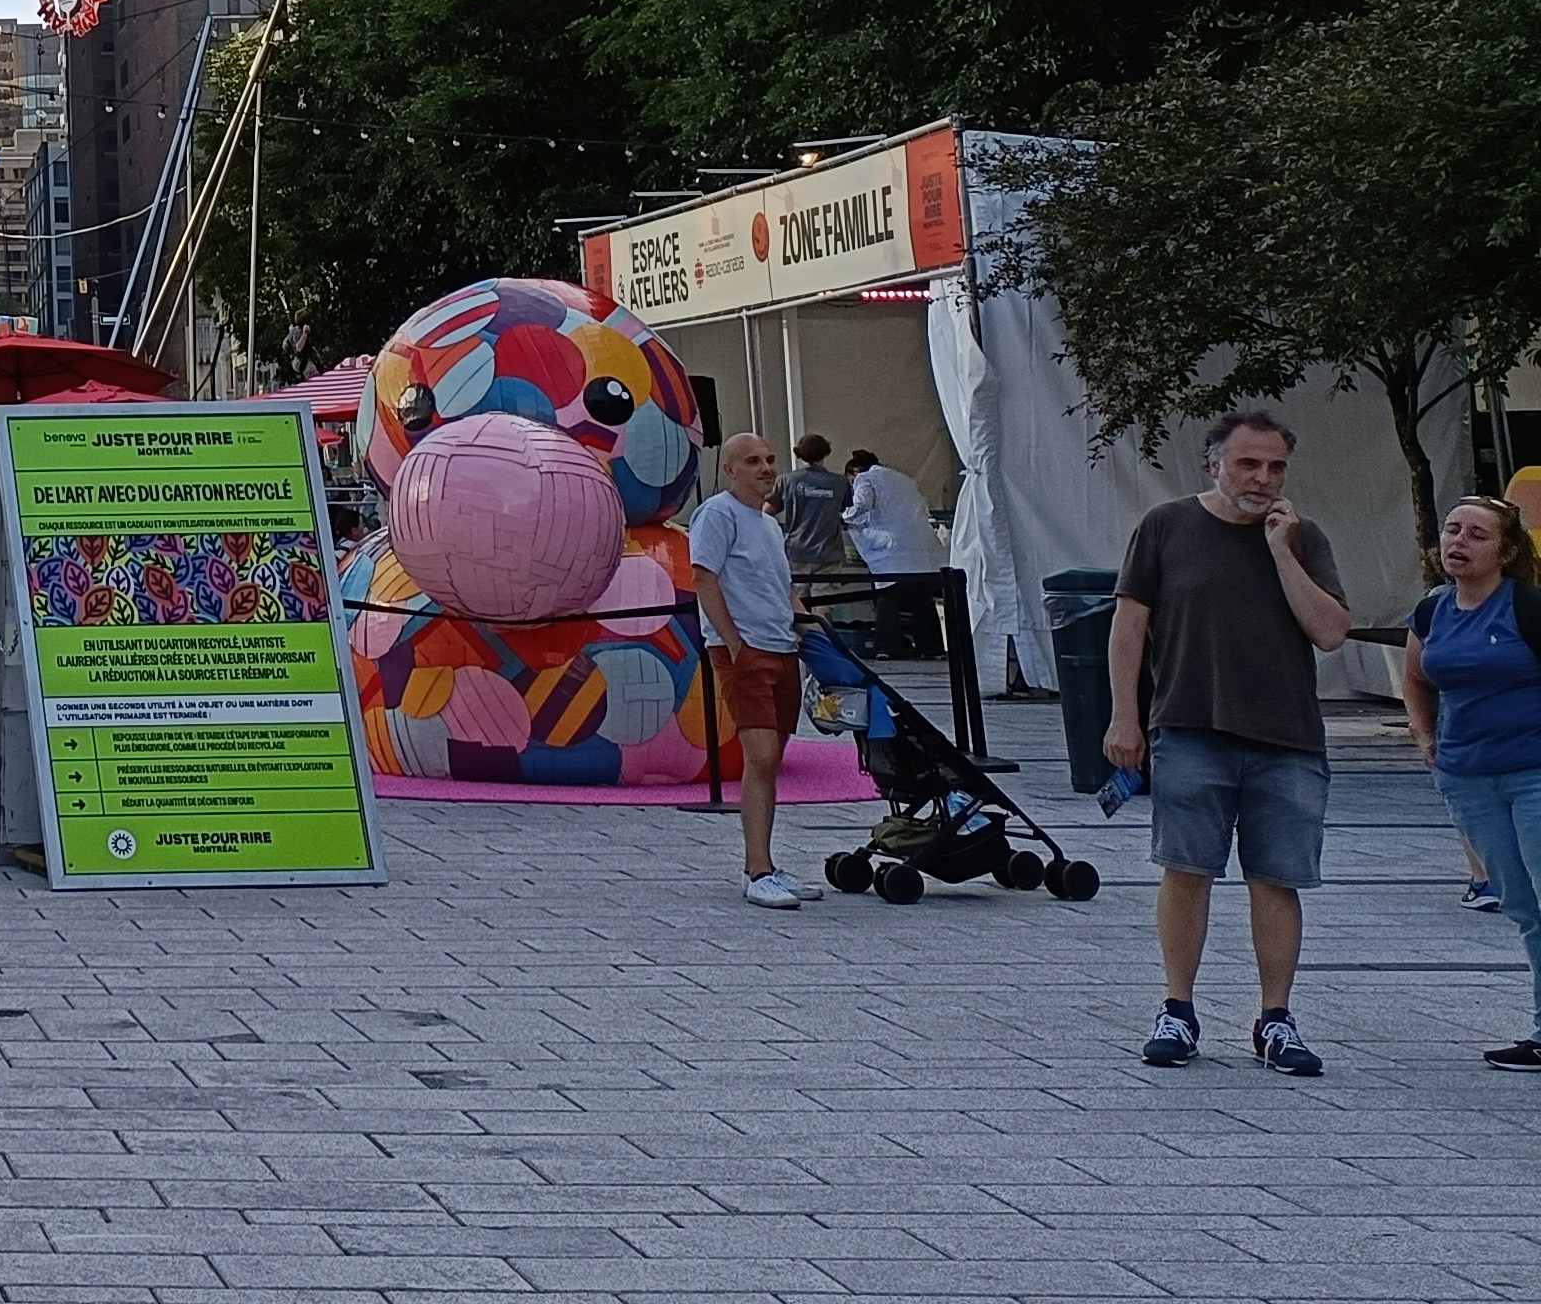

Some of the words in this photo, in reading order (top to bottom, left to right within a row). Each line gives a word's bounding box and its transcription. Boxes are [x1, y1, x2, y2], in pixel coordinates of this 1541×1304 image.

[920, 172, 942, 190] JUSTE
[923, 187, 942, 205] POUR
[924, 202, 942, 219] RIRE
[780, 207, 823, 265] ZONE
[823, 185, 894, 256] FAMILLE
[632, 231, 681, 274] ESPACE
[629, 267, 689, 311] ATELIERS
[43, 431, 86, 443] beneva
[91, 433, 144, 447] JUSTE
[148, 432, 194, 446] POUR
[196, 432, 234, 445] RIRE
[137, 446, 193, 456] MONTRÉAL
[34, 486, 54, 504] DE
[55, 485, 94, 504] L'ART
[98, 485, 136, 503] AVEC
[138, 484, 160, 502] DU
[161, 483, 226, 502] CARTON
[228, 478, 293, 501] RECYCLÉ
[84, 639, 95, 651] EN
[97, 639, 143, 651] UTILISANT
[144, 638, 159, 650] DU
[160, 638, 197, 650] CARTON
[244, 636, 286, 649] L'ARTISTE
[160, 651, 183, 666] CRÉE
[184, 653, 197, 665] DE
[198, 653, 210, 665] LA
[210, 652, 245, 665] VALEUR
[247, 652, 259, 664] EN
[260, 651, 316, 664] FAVORISANT
[88, 670, 101, 682] LA
[102, 668, 156, 682] RÉDUCTION
[157, 666, 164, 681] À
[166, 670, 178, 681] LA
[179, 669, 216, 681] SOURCE
[217, 668, 228, 680] ET
[229, 668, 241, 679] LE
[56, 703, 89, 711] DONNER
[91, 703, 107, 711] UNE
[109, 702, 146, 710] SECONDE
[147, 700, 176, 710] UTILITÉ
[185, 701, 197, 709] UN
[198, 701, 224, 709] OBJET
[225, 700, 237, 708] OU
[239, 700, 255, 708] UNE
[291, 699, 313, 707] DONT
[114, 712, 151, 720] PRIMAIRE
[153, 712, 167, 720] EST
[155, 833, 200, 845] JUSTE
[201, 832, 240, 845] POUR
[241, 832, 272, 844] RIRE
[193, 844, 239, 853] MONTRÉAL
